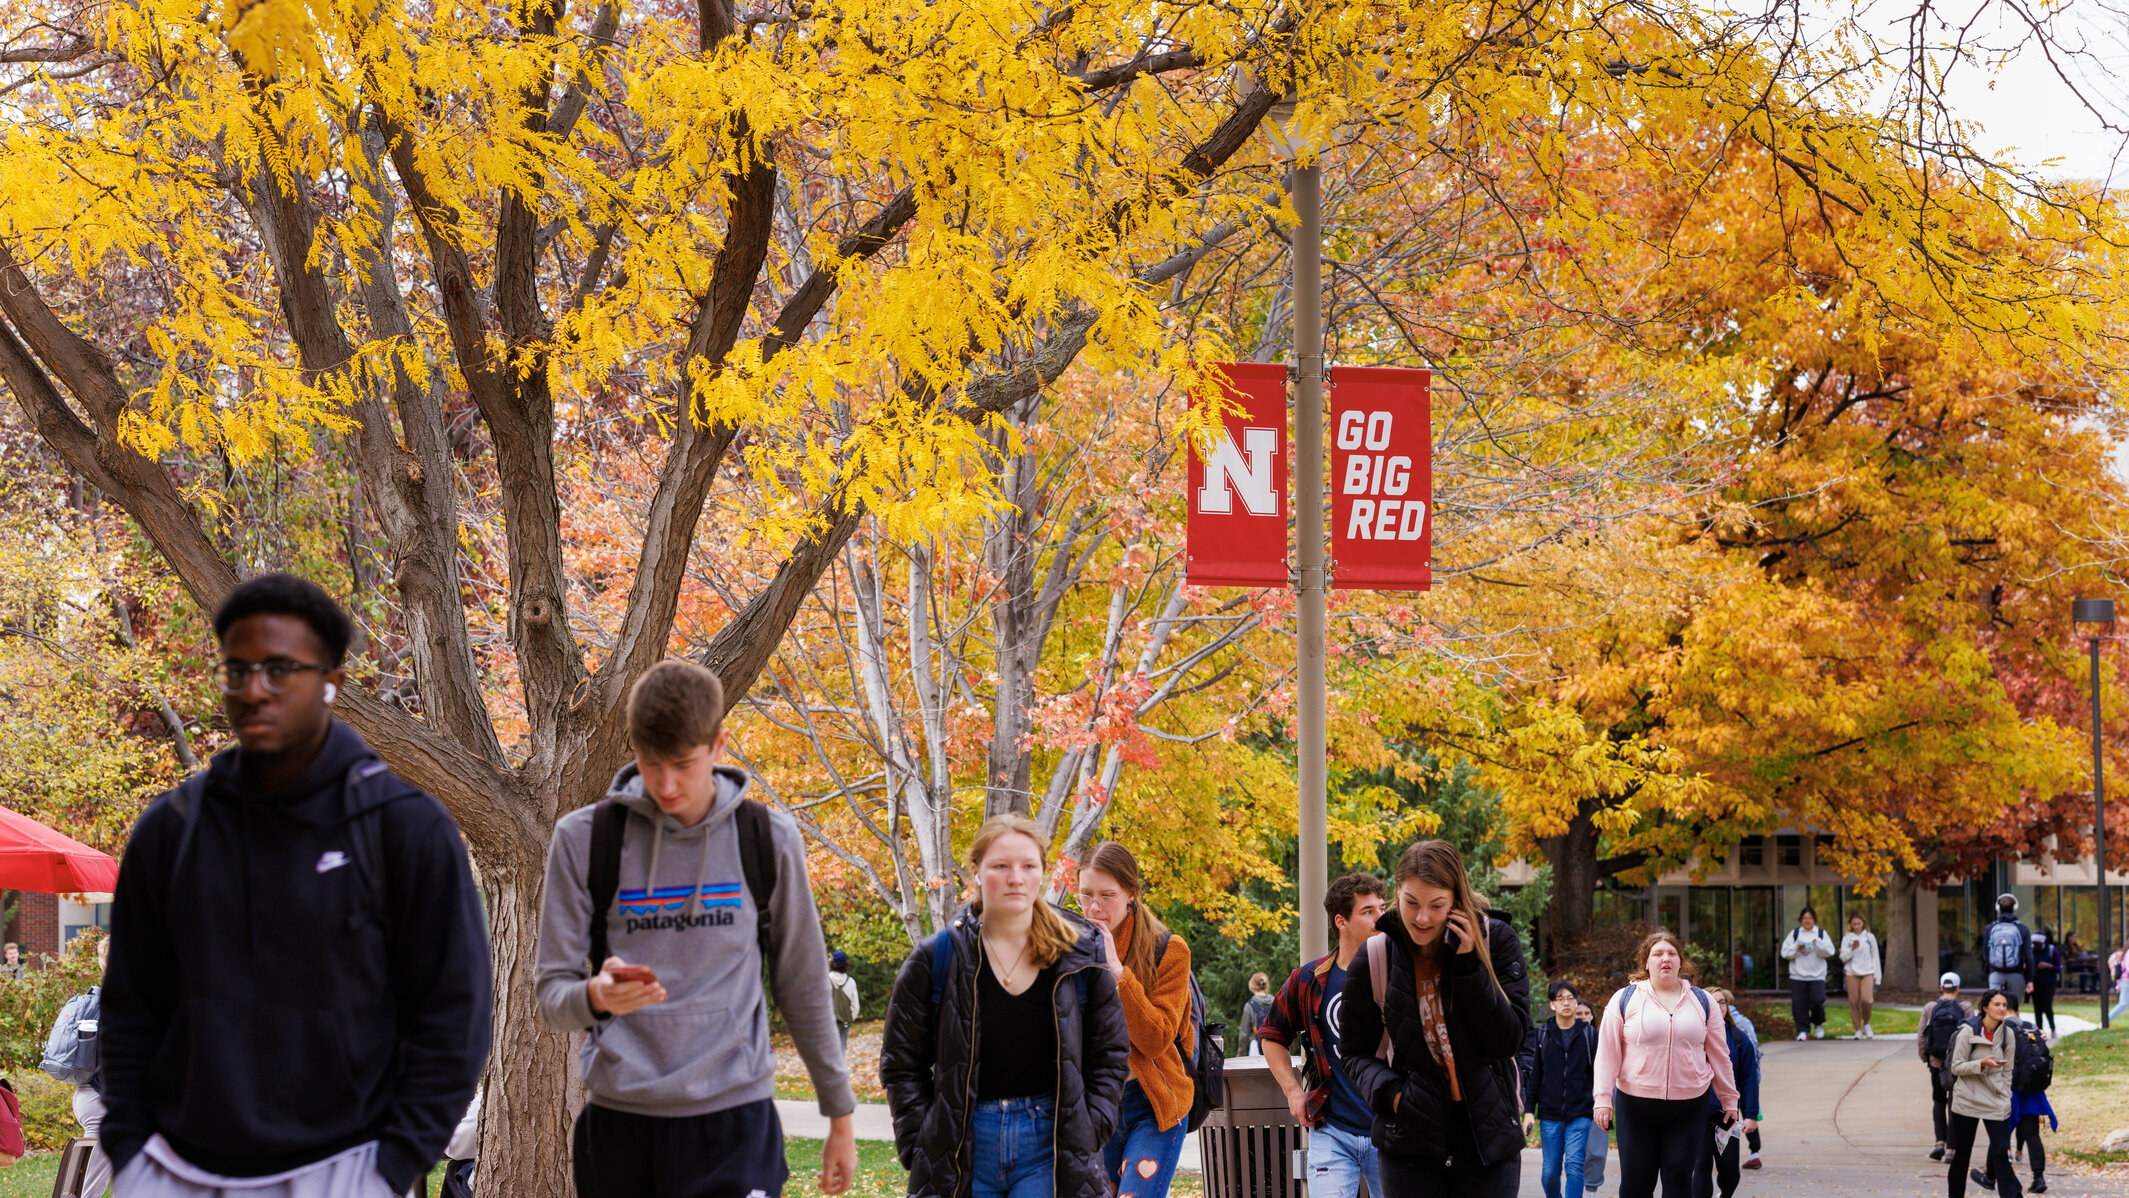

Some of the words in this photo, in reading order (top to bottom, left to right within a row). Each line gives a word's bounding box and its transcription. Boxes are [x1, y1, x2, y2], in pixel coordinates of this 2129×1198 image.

[1337, 410, 1393, 451] GO
[1198, 425, 1278, 516] N
[1343, 454, 1412, 496] BIG
[1347, 499, 1426, 541] RED
[626, 909, 734, 934] patagonia
